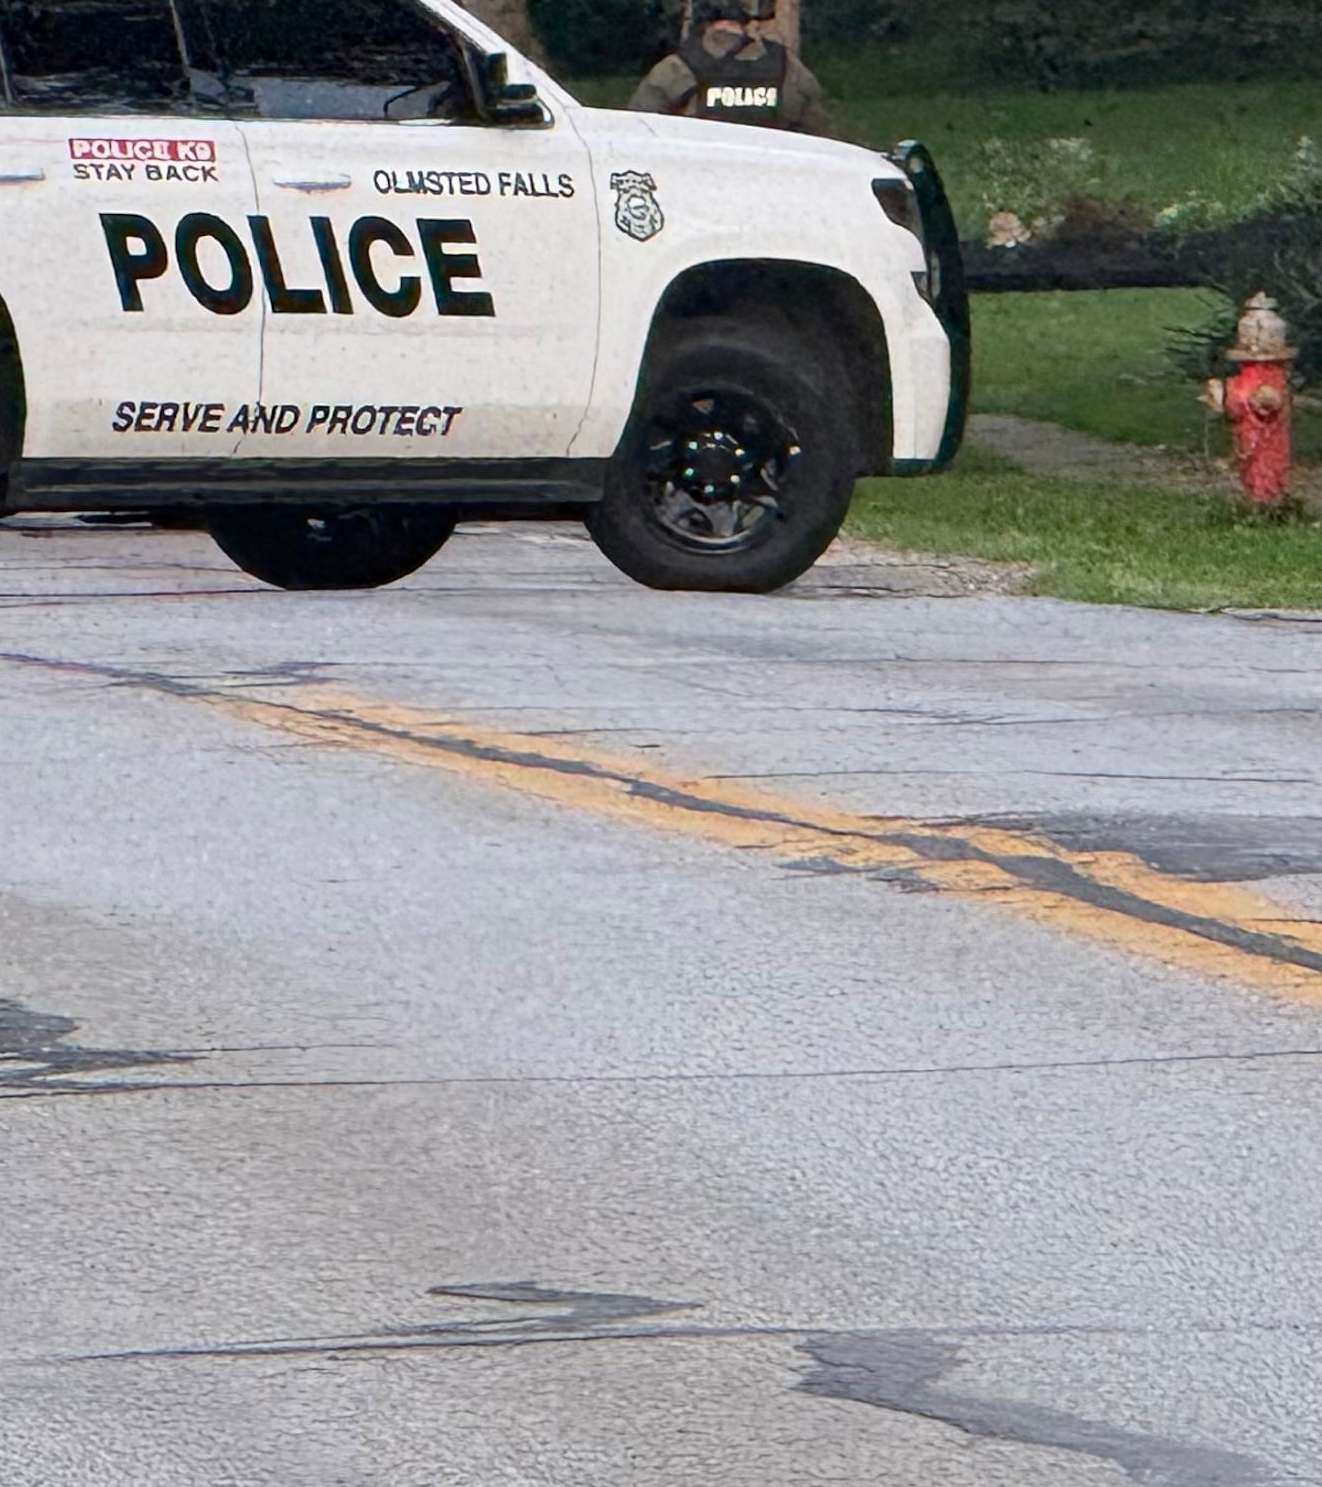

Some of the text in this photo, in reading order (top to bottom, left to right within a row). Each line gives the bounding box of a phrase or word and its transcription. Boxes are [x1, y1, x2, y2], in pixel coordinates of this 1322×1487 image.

[706, 86, 777, 107] POLICE
[72, 140, 212, 162] POLICE K9
[73, 164, 219, 182] STAY BACK
[373, 169, 575, 198] OLMSTED FALLS
[99, 212, 496, 317] POLICE
[111, 401, 463, 437] SERVE AND PROTECT
